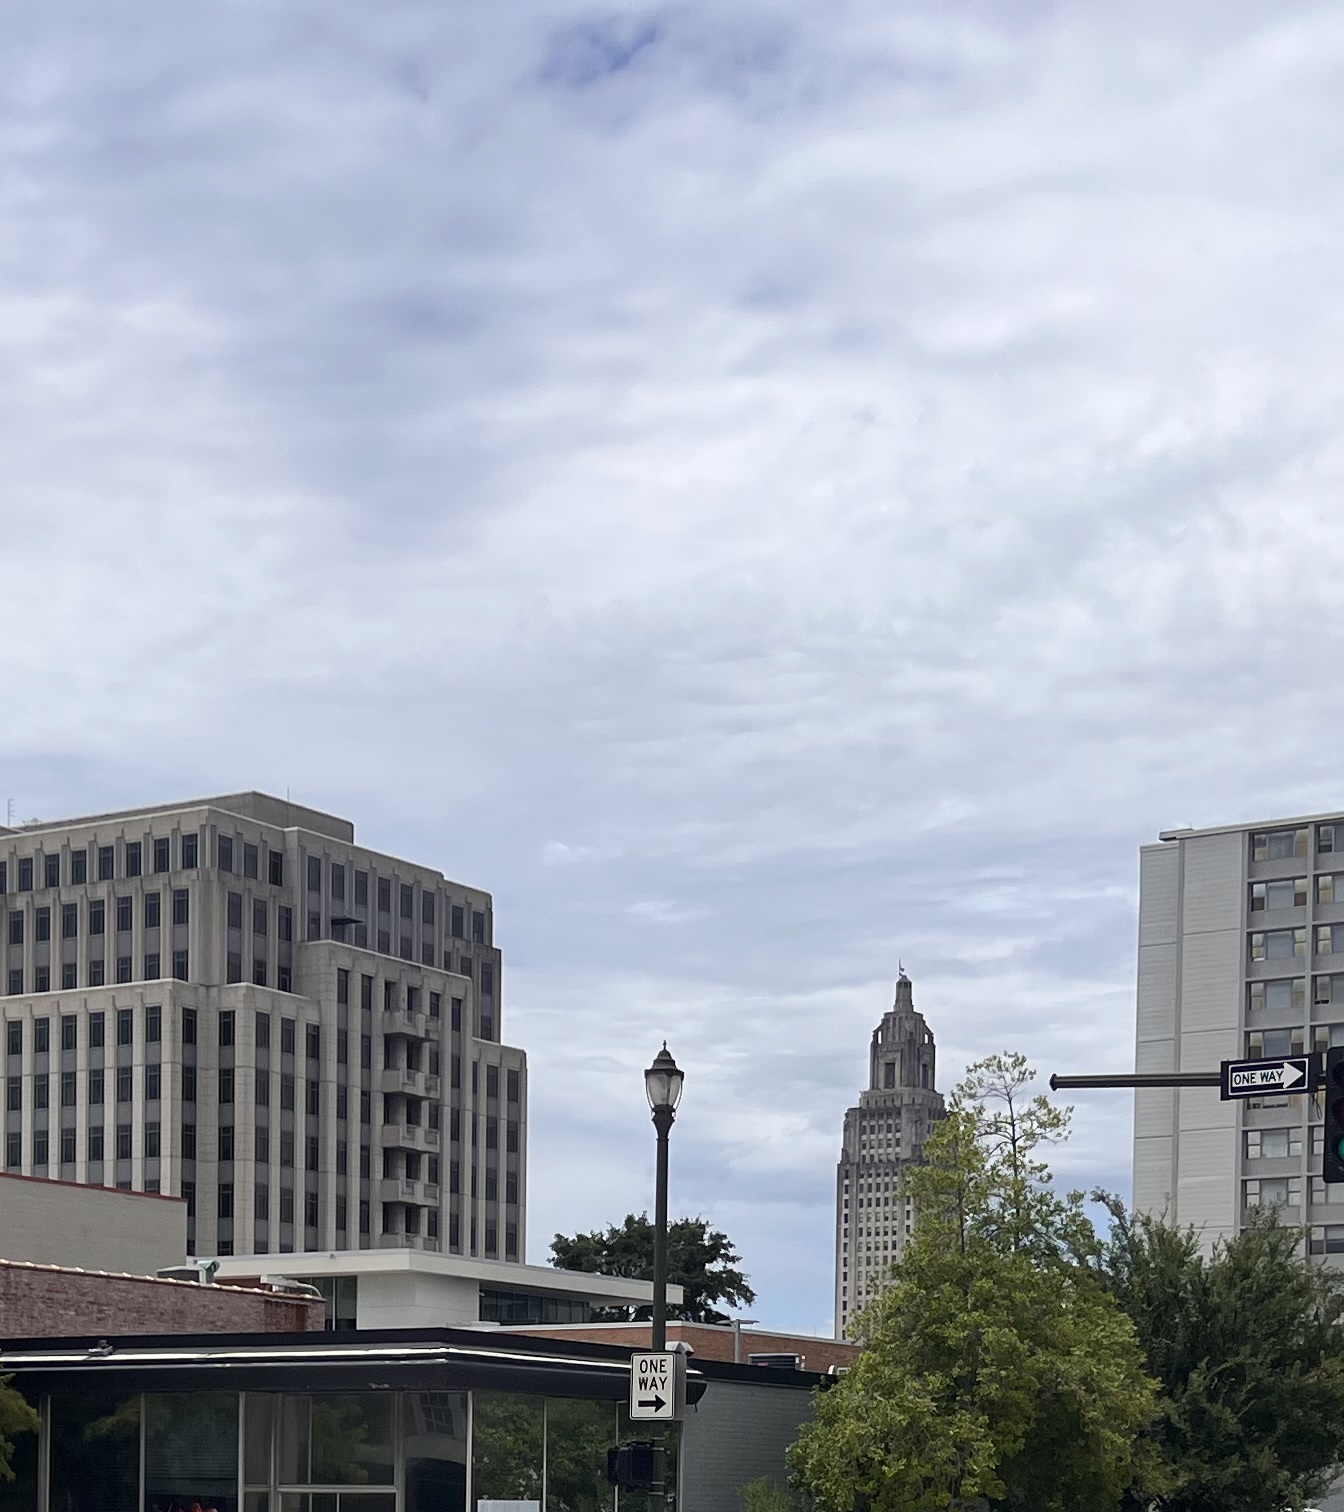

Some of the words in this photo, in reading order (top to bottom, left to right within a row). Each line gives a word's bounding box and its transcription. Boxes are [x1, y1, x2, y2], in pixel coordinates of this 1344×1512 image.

[1233, 1072, 1256, 1085] ONE
[1259, 1070, 1284, 1083] WAY
[639, 1358, 668, 1374] ONE
[637, 1376, 669, 1391] WAY
